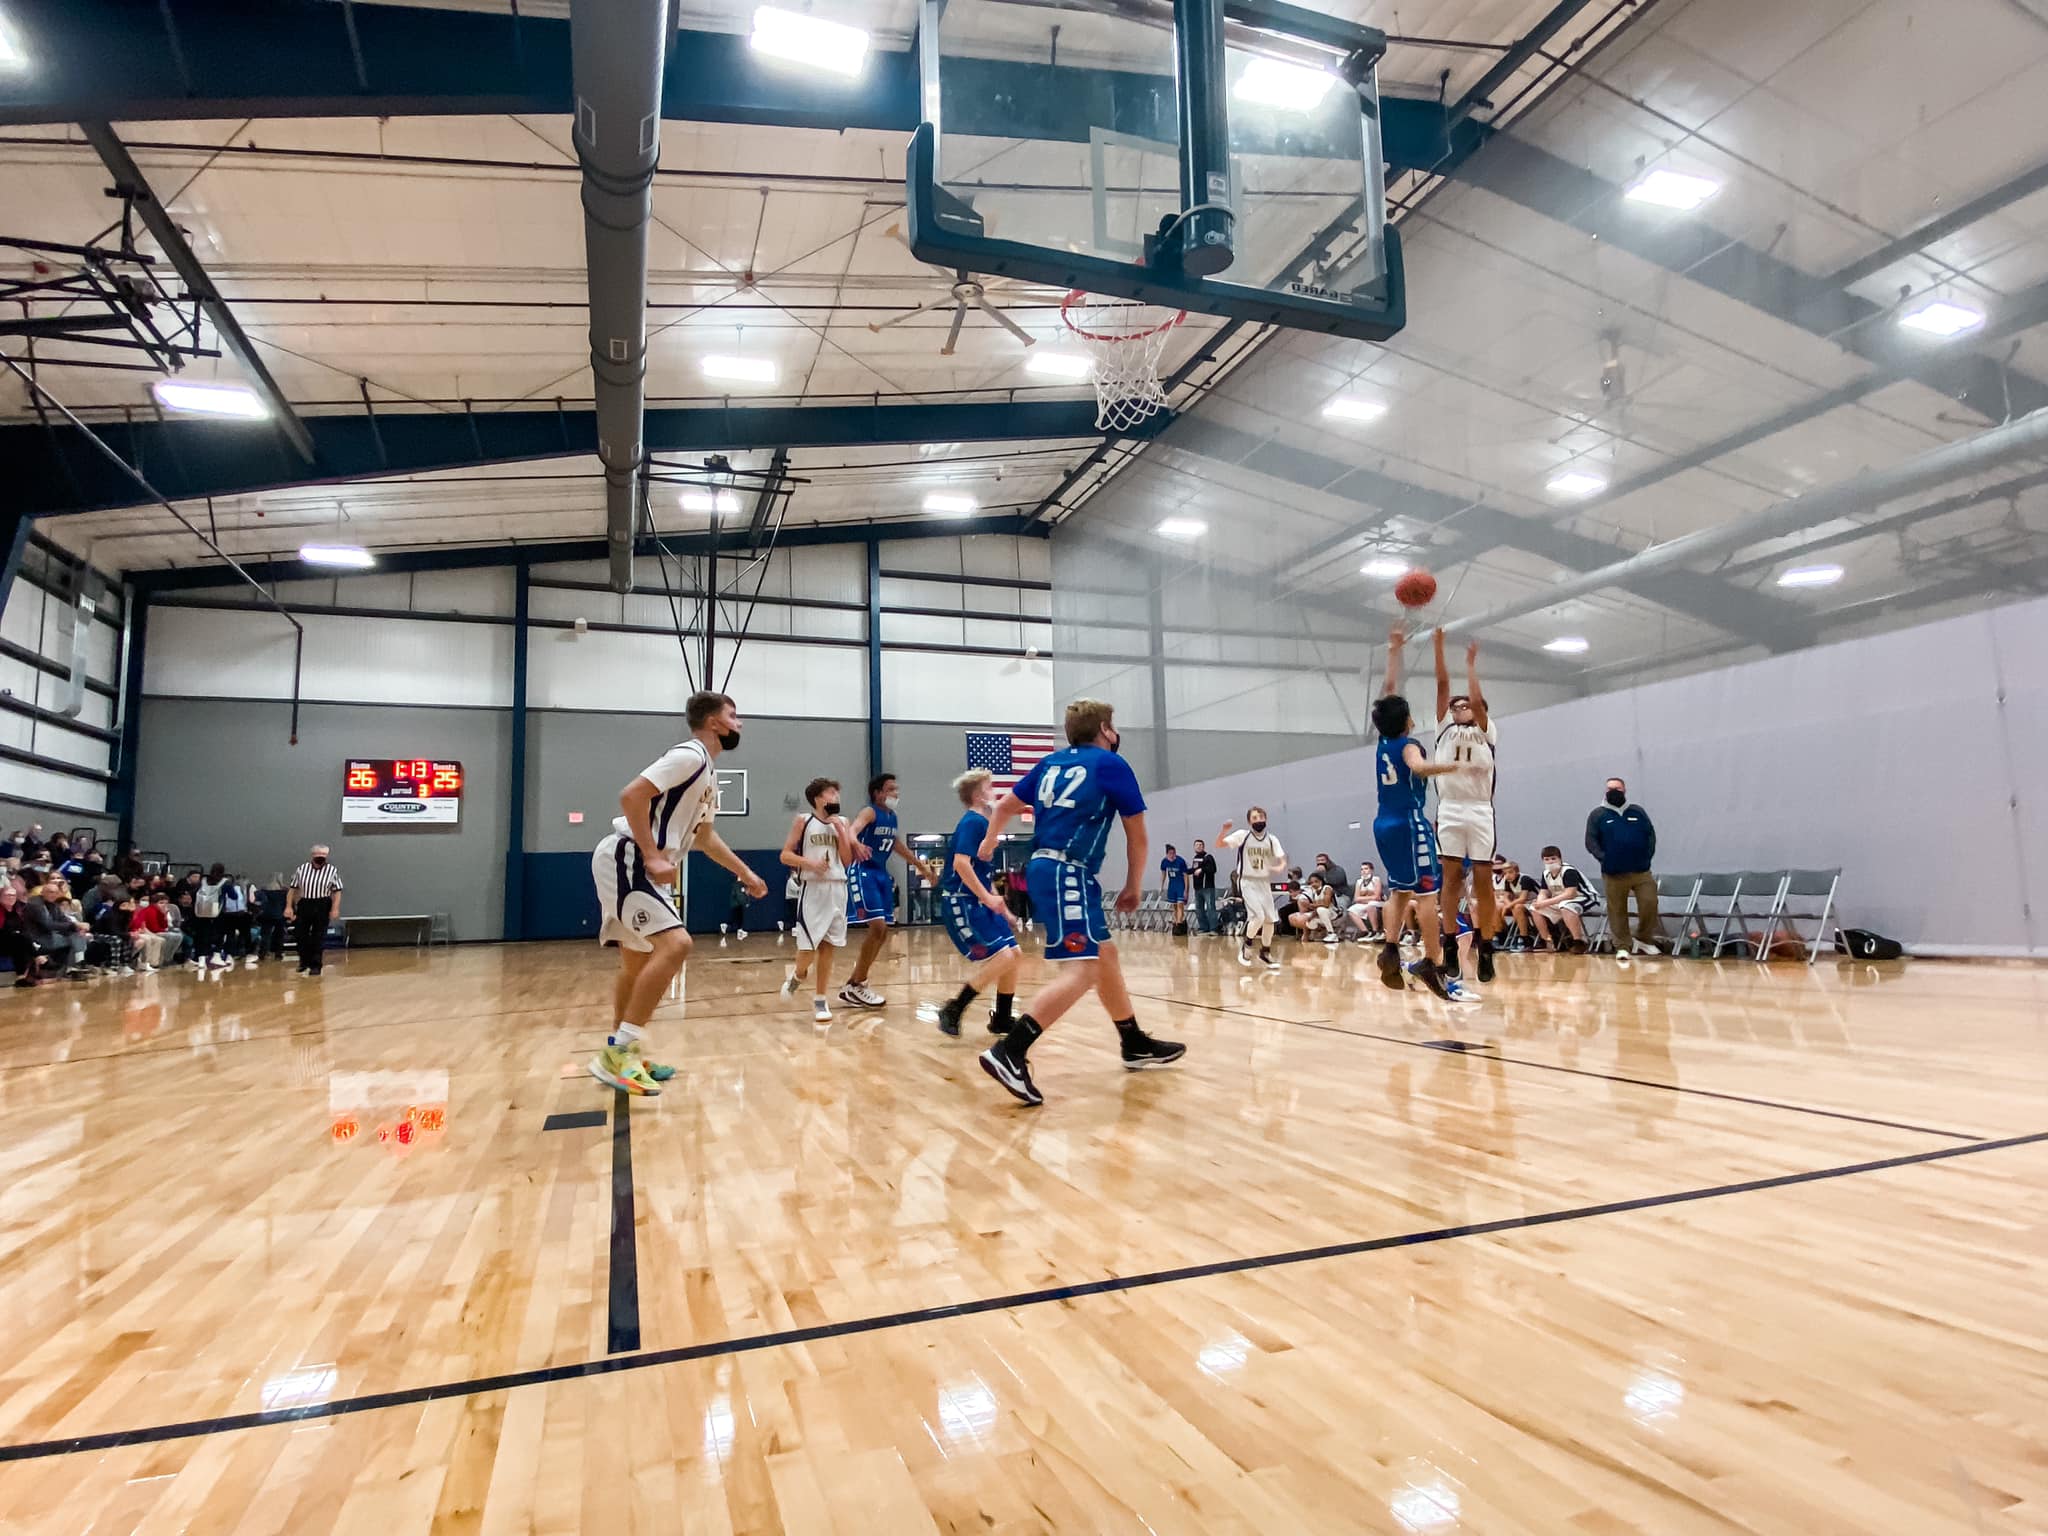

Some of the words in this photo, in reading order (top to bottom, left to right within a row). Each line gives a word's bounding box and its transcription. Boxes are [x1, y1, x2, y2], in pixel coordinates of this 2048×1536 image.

[1381, 753, 1398, 785] 3
[349, 770, 376, 787] 26
[433, 771, 459, 788] 25
[1038, 765, 1087, 808] 42
[419, 784, 428, 797] 3
